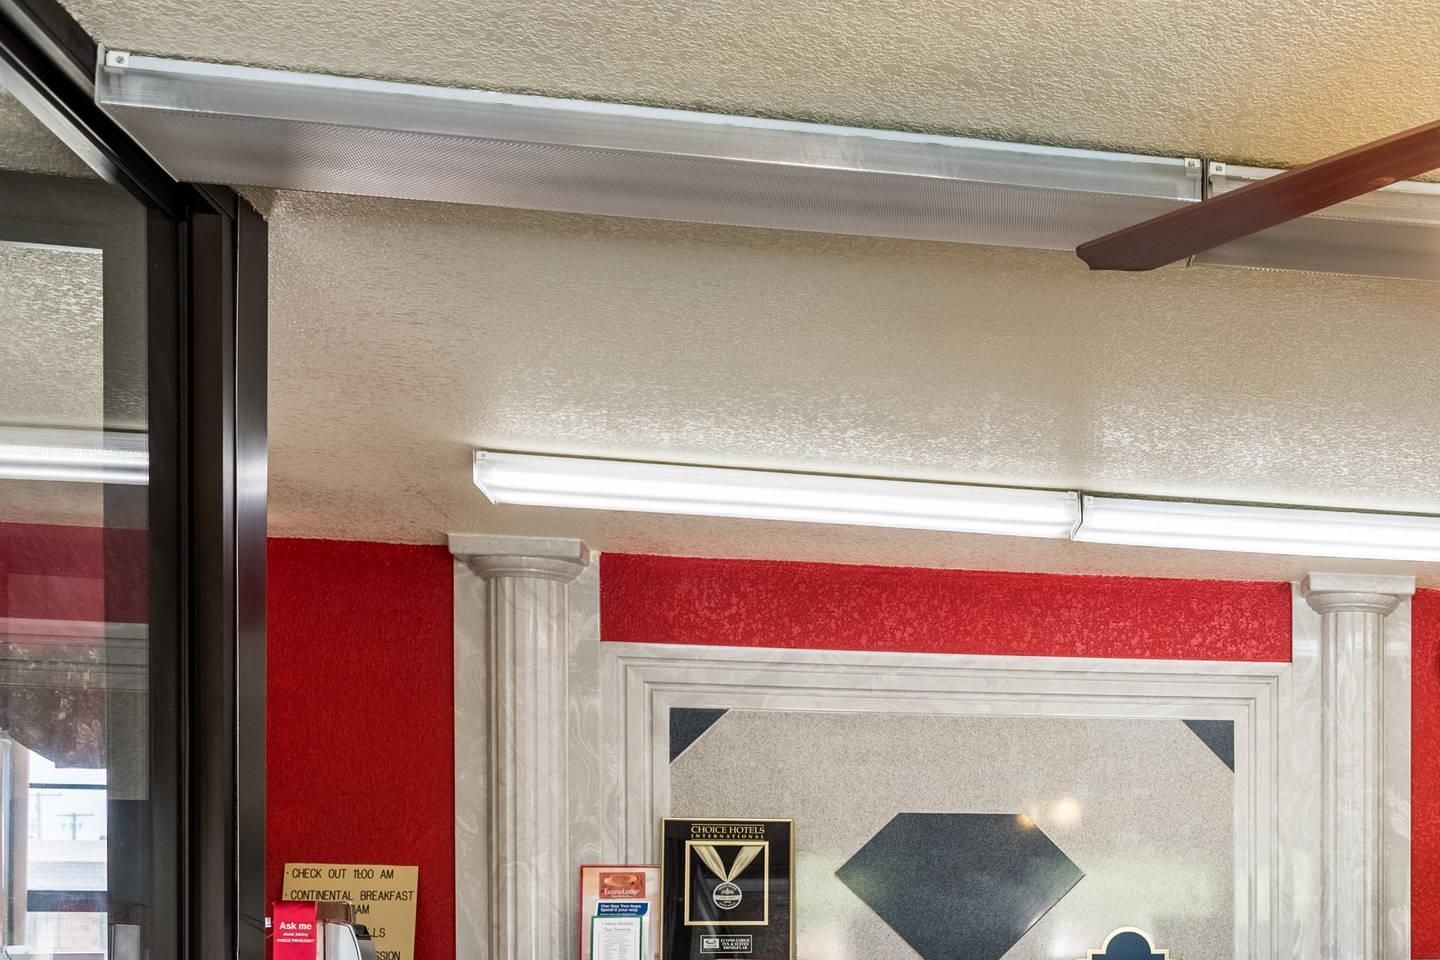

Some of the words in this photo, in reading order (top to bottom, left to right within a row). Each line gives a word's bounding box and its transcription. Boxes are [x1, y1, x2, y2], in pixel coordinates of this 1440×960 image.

[690, 825, 727, 834] CHOICE
[729, 826, 765, 834] HOTELS
[291, 868, 322, 879] CHECK
[328, 868, 346, 880] OUT
[379, 869, 394, 880] AM
[290, 889, 353, 901] CONTINENTAL
[360, 890, 415, 901] BREAKFAST
[280, 921, 297, 930] Ask
